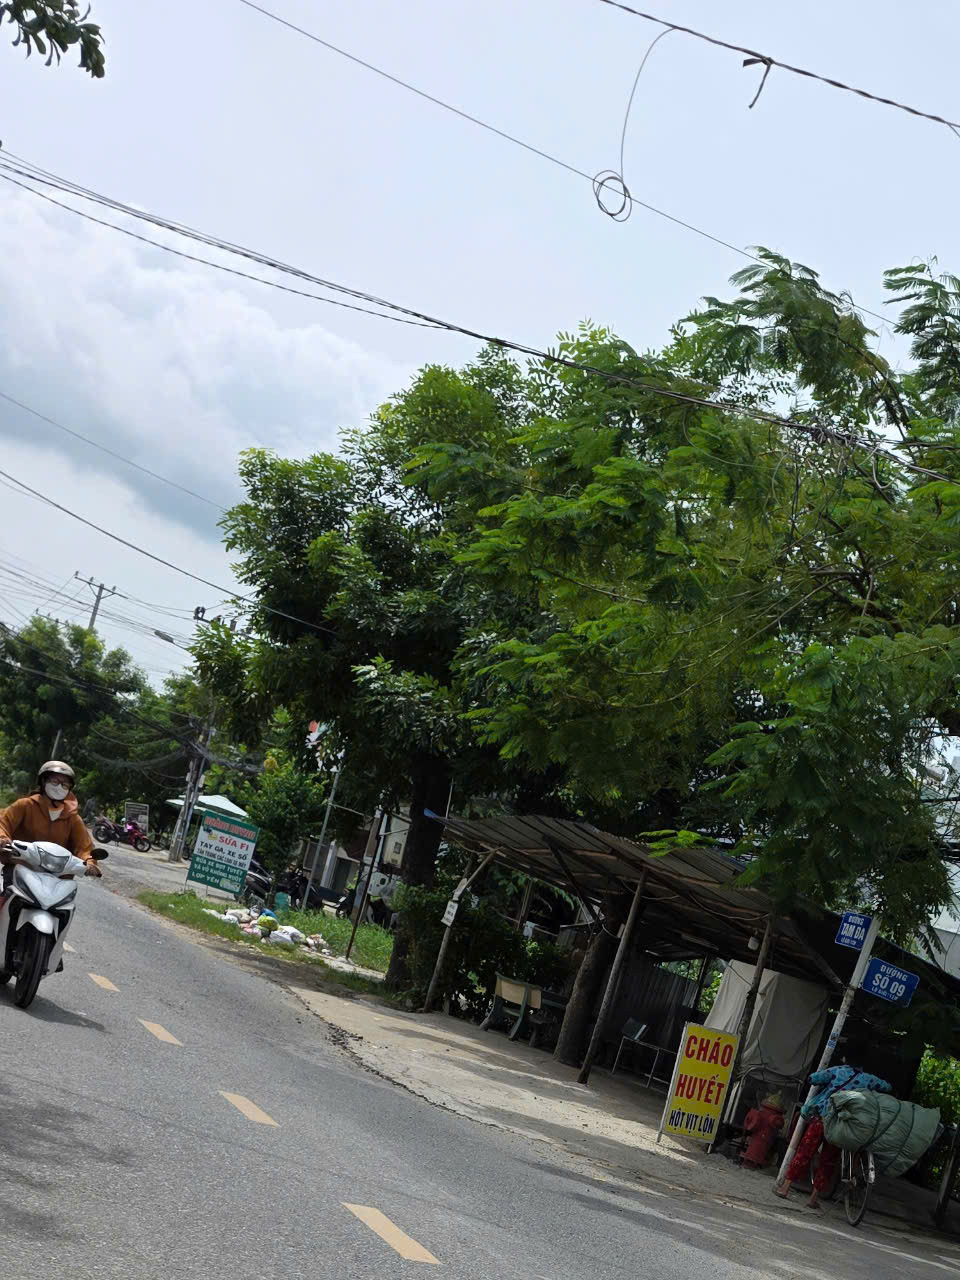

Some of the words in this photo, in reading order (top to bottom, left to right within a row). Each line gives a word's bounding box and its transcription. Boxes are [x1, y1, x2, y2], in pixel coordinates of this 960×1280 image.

[200, 841, 213, 849] TAY
[228, 849, 237, 857] XE
[872, 973, 892, 989] SỐ
[890, 981, 906, 997] 09
[685, 1035, 733, 1067] CHÁO
[675, 1074, 725, 1105] HUYẾT
[668, 1108, 686, 1130] HỘT
[685, 1113, 699, 1133] VỊT
[698, 1113, 715, 1136] LỘN
